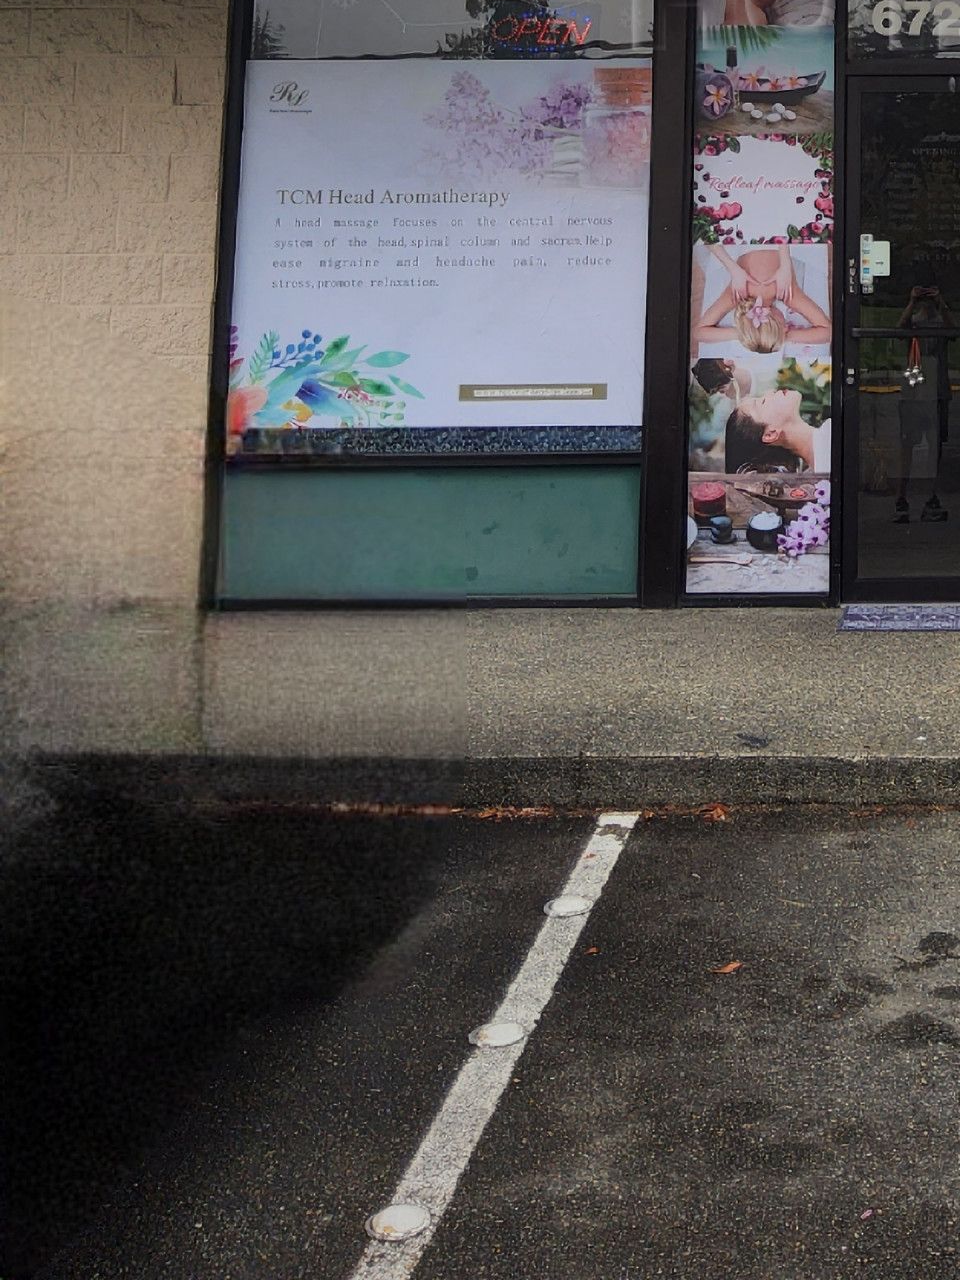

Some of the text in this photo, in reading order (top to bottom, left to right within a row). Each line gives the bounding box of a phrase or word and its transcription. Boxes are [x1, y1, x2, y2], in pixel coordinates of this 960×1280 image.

[492, 17, 592, 44] OPEN
[277, 190, 511, 206] TCM Head Aromatherapy
[393, 217, 437, 227] focuses
[477, 217, 496, 227] the
[324, 238, 336, 248] of
[349, 237, 367, 247] the
[511, 237, 530, 246] and
[272, 259, 302, 268] ease
[396, 257, 419, 268] and
